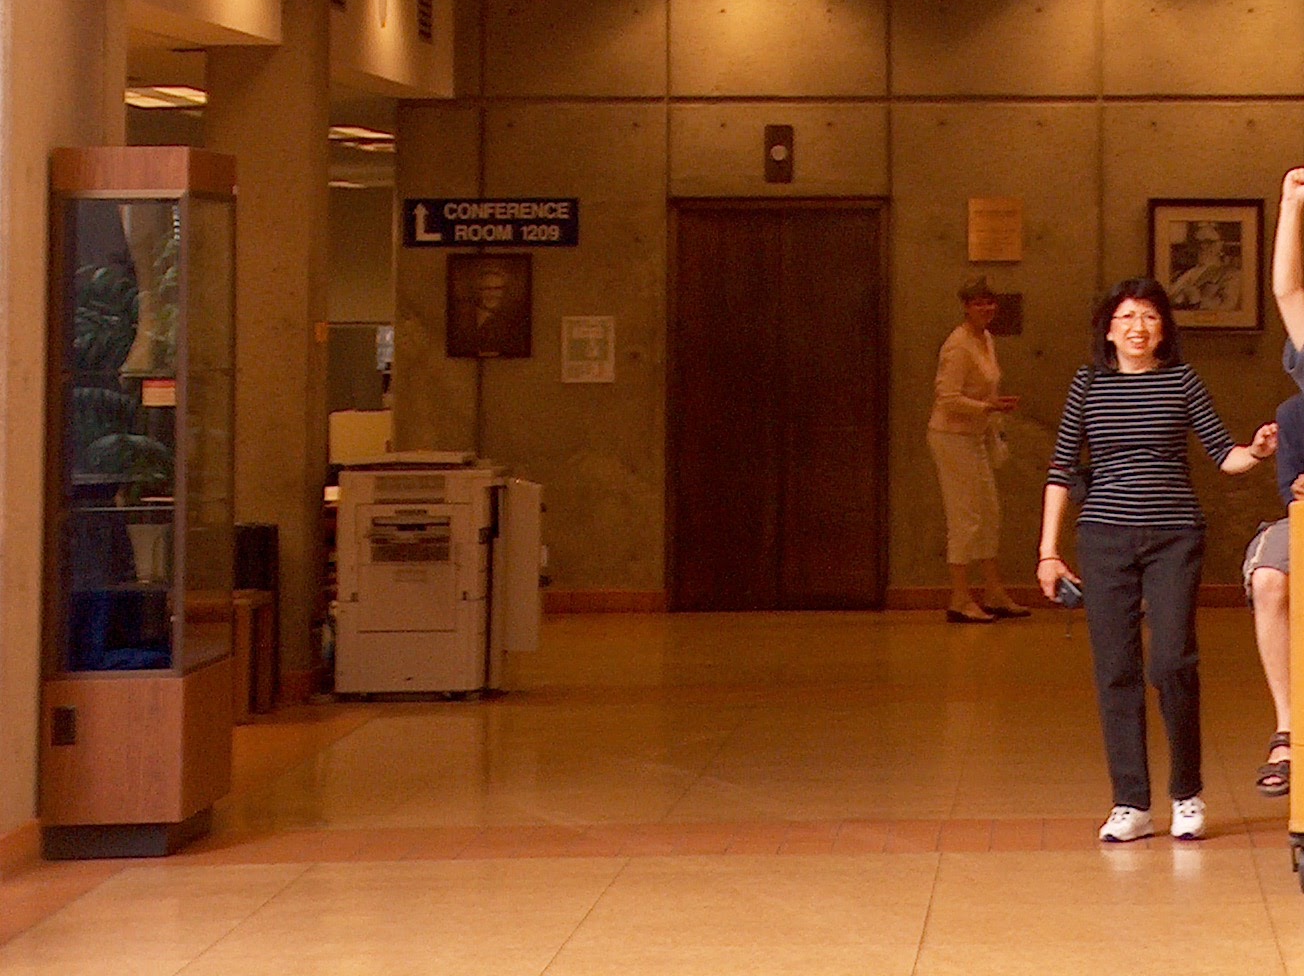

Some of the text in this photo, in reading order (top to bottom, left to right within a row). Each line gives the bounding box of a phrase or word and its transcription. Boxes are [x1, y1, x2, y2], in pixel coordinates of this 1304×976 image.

[443, 202, 570, 220] CONFERENCE
[454, 224, 561, 241] ROOM 1209
